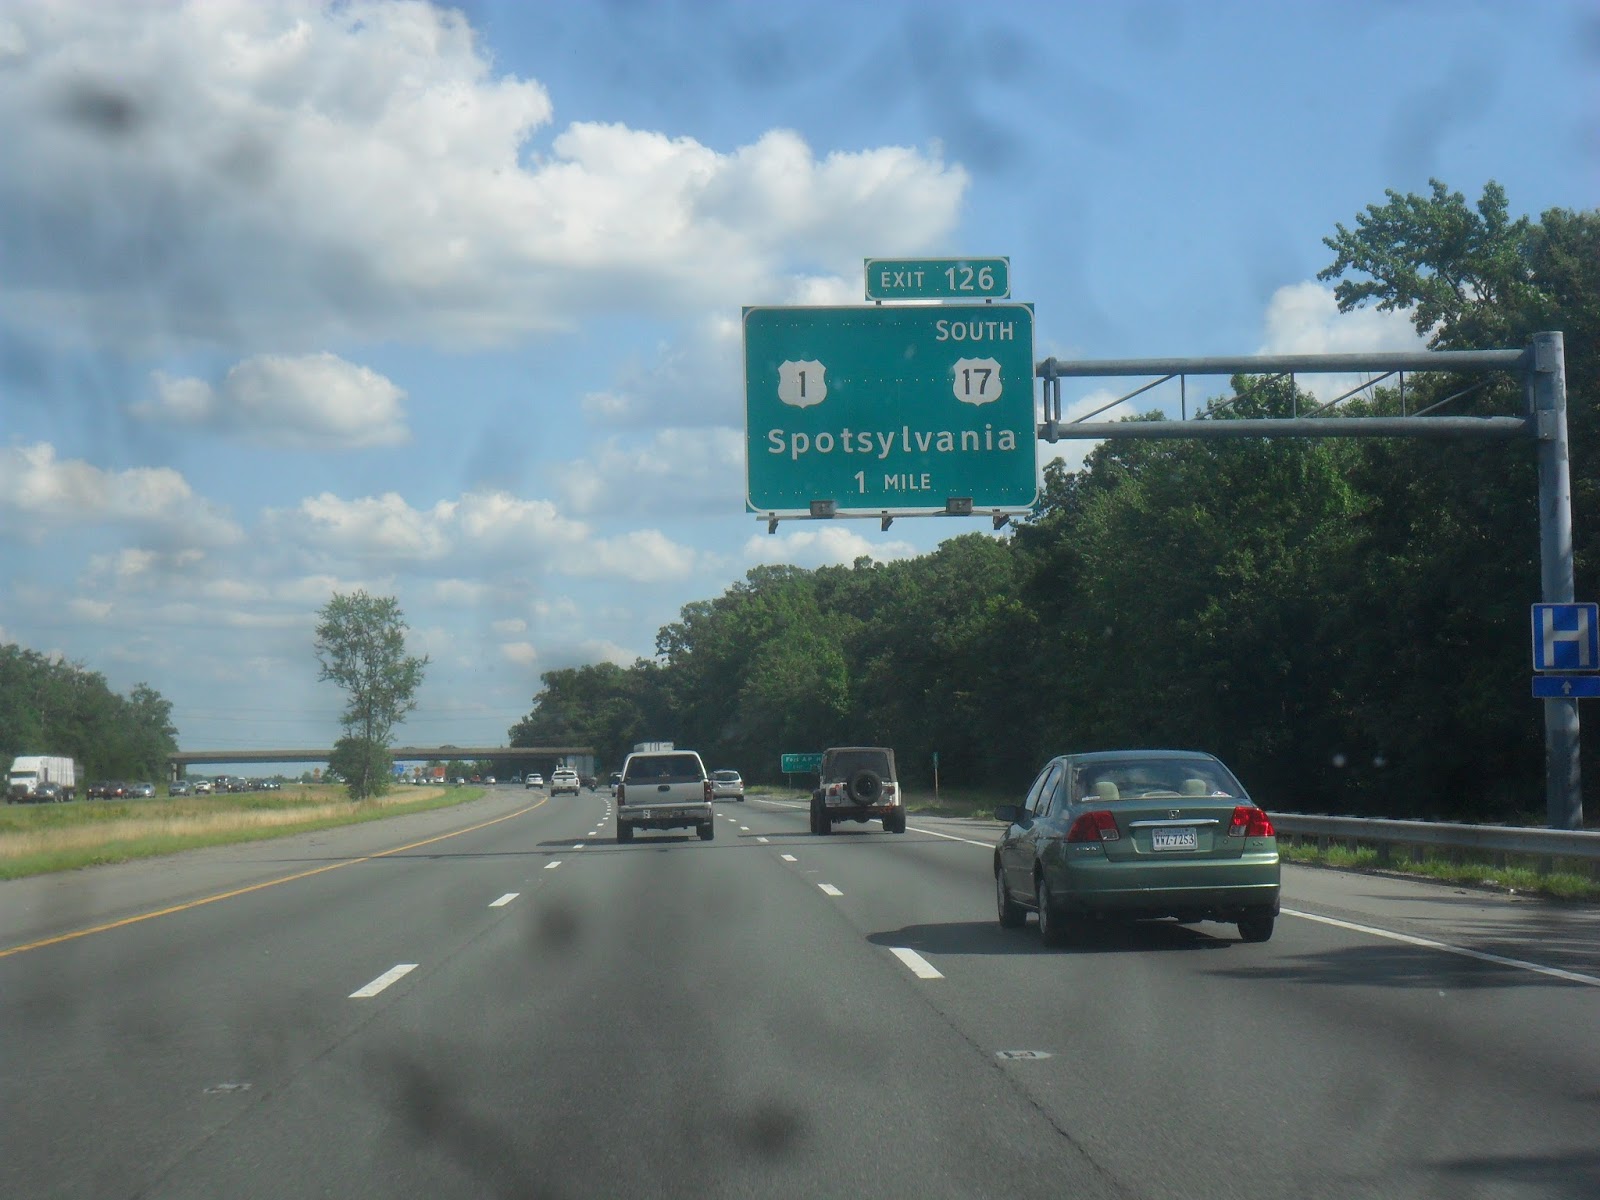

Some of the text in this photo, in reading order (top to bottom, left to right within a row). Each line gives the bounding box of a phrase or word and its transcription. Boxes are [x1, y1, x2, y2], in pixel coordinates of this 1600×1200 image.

[881, 267, 995, 291] EXIT 126
[935, 319, 1014, 341] SOUTH
[798, 370, 807, 398] 1
[962, 368, 992, 395] 17
[767, 424, 1016, 460] Spotsylvania
[854, 470, 931, 494] 1 MILE
[1542, 608, 1590, 667] H
